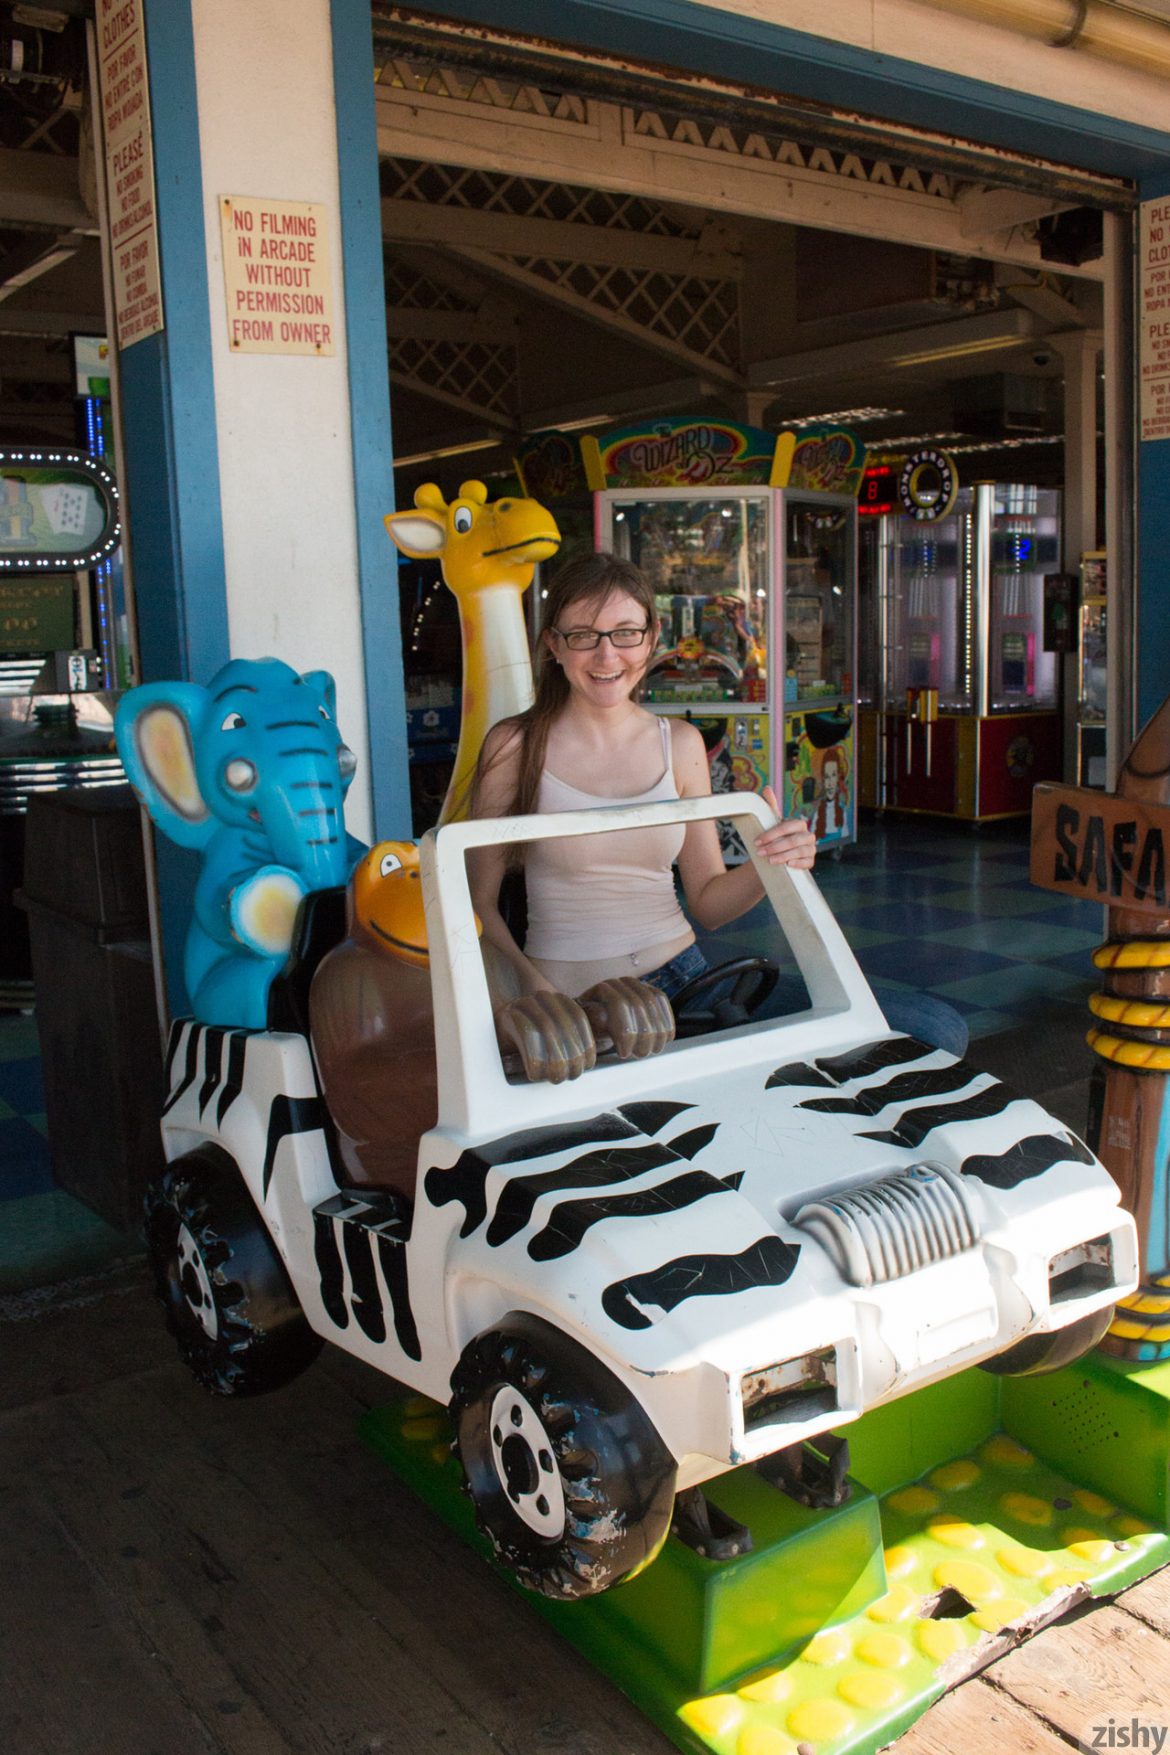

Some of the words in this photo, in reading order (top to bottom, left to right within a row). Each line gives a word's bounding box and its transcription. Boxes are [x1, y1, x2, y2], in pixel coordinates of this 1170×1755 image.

[113, 137, 144, 177] PLEASE
[233, 210, 253, 231] NO
[260, 212, 316, 237] FILMING
[1151, 205, 1170, 223] PLE
[1149, 226, 1164, 243] NO
[260, 238, 315, 263] ARCADE
[1149, 245, 1170, 262] CLO
[246, 263, 311, 288] WITHOUT
[236, 290, 324, 315] PERMISSION
[233, 319, 274, 341] FROM
[280, 321, 331, 344] OWNER
[1150, 323, 1170, 337] PLE
[633, 425, 712, 472] WIZARD
[1054, 804, 1170, 908] SAFA
